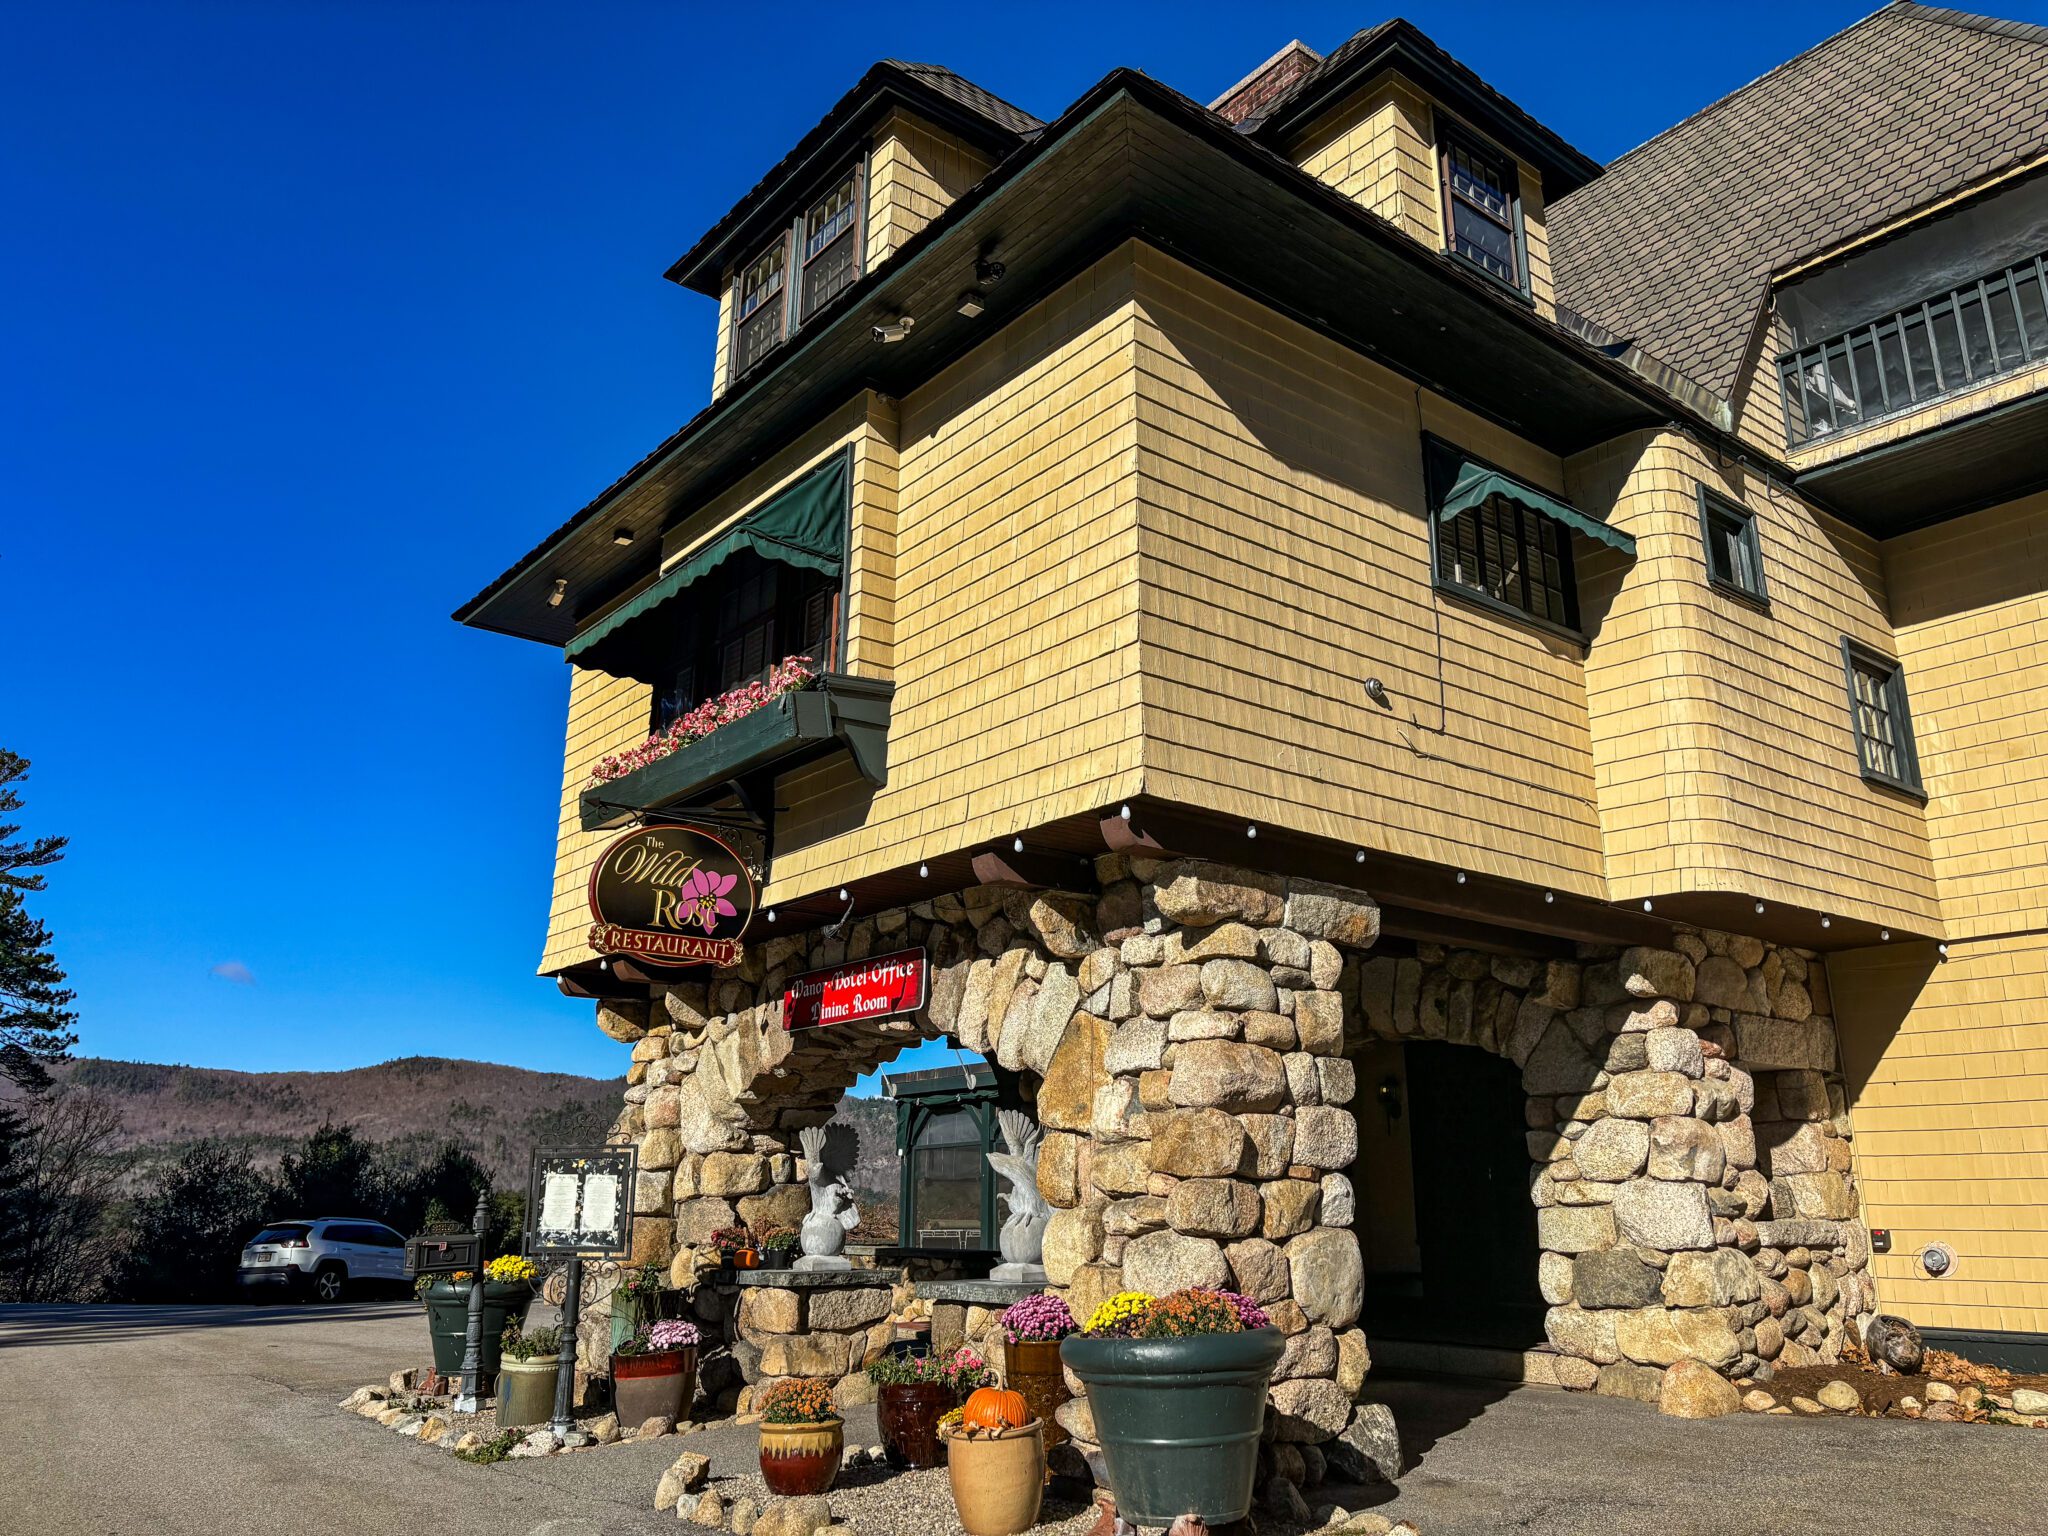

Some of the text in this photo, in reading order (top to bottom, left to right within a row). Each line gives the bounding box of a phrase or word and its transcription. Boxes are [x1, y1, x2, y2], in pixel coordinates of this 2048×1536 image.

[645, 836, 665, 849] The
[615, 844, 703, 889] Wild
[647, 888, 720, 930] Rose
[610, 930, 730, 959] RESTAURANT
[871, 959, 914, 986] Office
[853, 993, 888, 1014] Room
